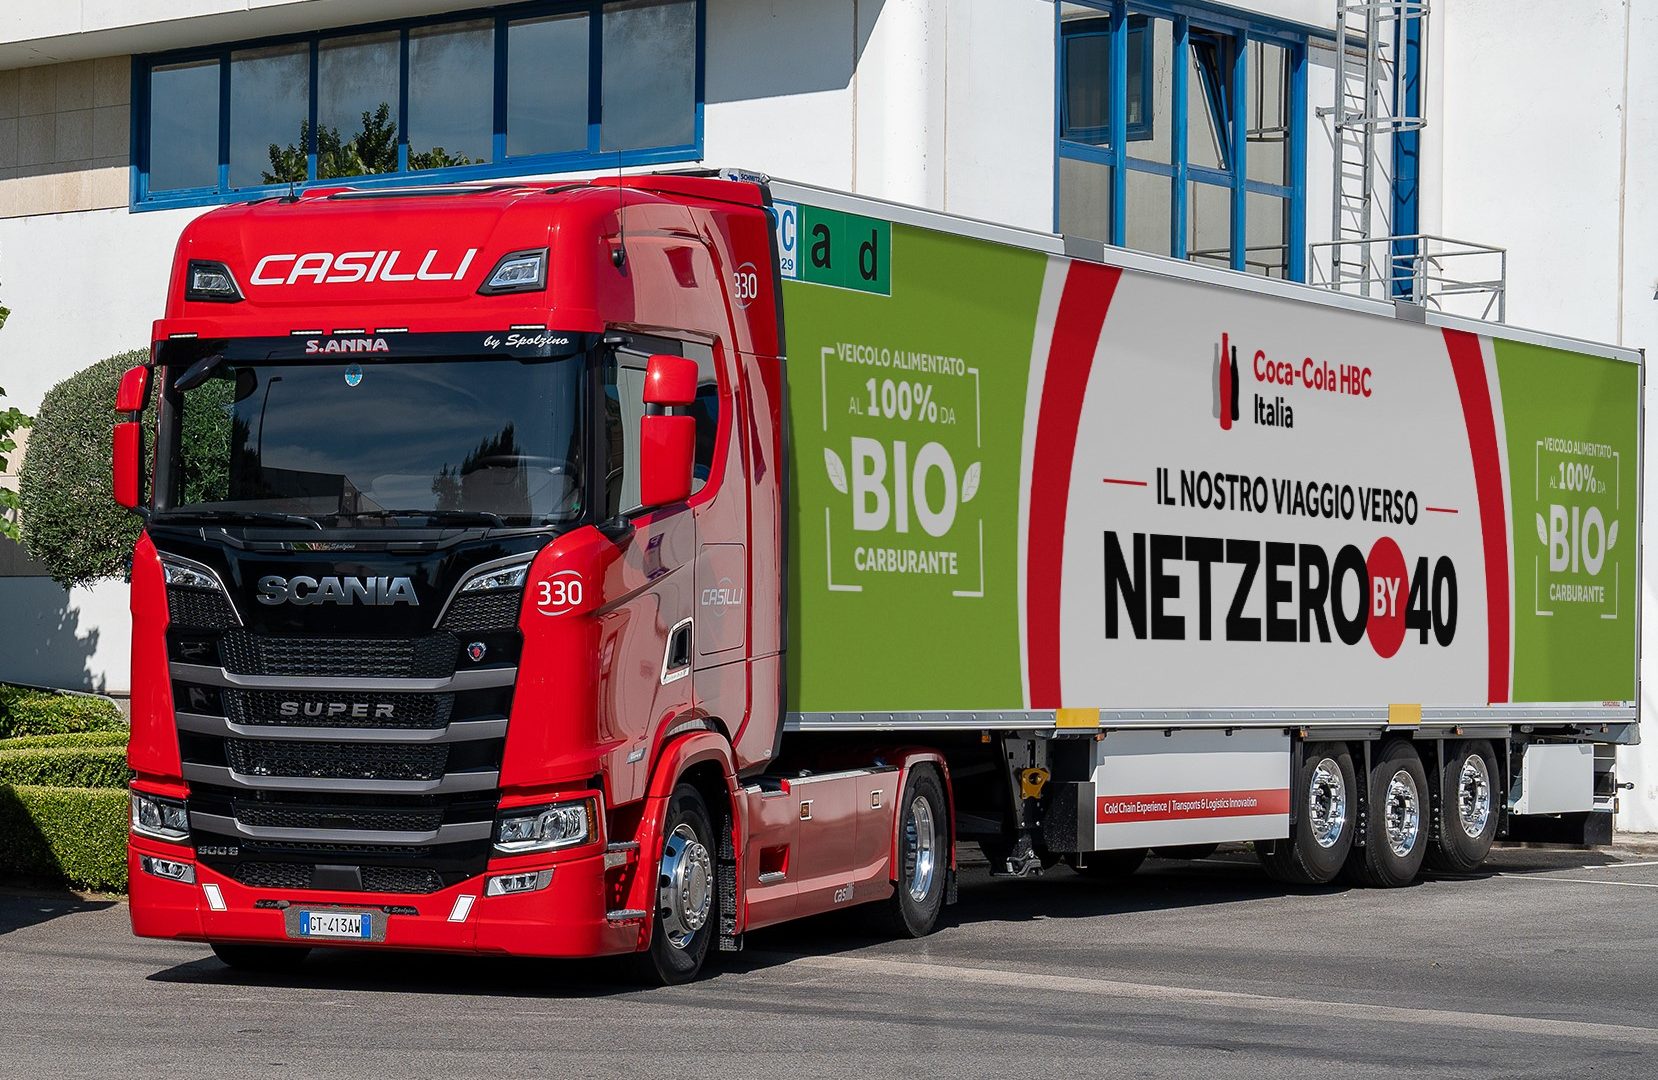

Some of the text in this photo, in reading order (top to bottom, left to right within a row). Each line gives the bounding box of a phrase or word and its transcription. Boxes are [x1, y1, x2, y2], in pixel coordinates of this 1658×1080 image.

[250, 248, 478, 285] CASILLI
[811, 223, 878, 281] a d
[733, 272, 758, 299] 330
[305, 338, 389, 354] S.ANNA
[483, 334, 569, 350] by Spolzino
[836, 342, 966, 376] VEICOLO ALIMENTATO
[1254, 350, 1372, 398] Coca-Cola HBC
[848, 378, 956, 425] AL 100% DA
[1254, 393, 1294, 429] Italia
[1544, 437, 1612, 459] VEICOLO ALIMENTATO
[850, 436, 958, 538] BIO
[1550, 462, 1607, 494] AL 100% DA
[1156, 467, 1418, 526] IL NOSTRO VIAGGIO VERSO
[1550, 504, 1606, 576] BIO
[854, 546, 959, 576] CARBURANTE
[256, 575, 420, 606] SCANIA
[536, 580, 583, 607] 330
[701, 588, 744, 606] CASILLI
[1103, 530, 1459, 648] NETZERO BY 40
[1549, 583, 1605, 603] CARBURANTE
[280, 701, 395, 718] SUPER
[1103, 802, 1119, 814] Cold
[1118, 801, 1137, 814] Chain
[1136, 800, 1168, 814] Experience
[1171, 799, 1201, 812] Transports
[1205, 797, 1230, 811] Logistics
[1229, 796, 1258, 809] Innovation
